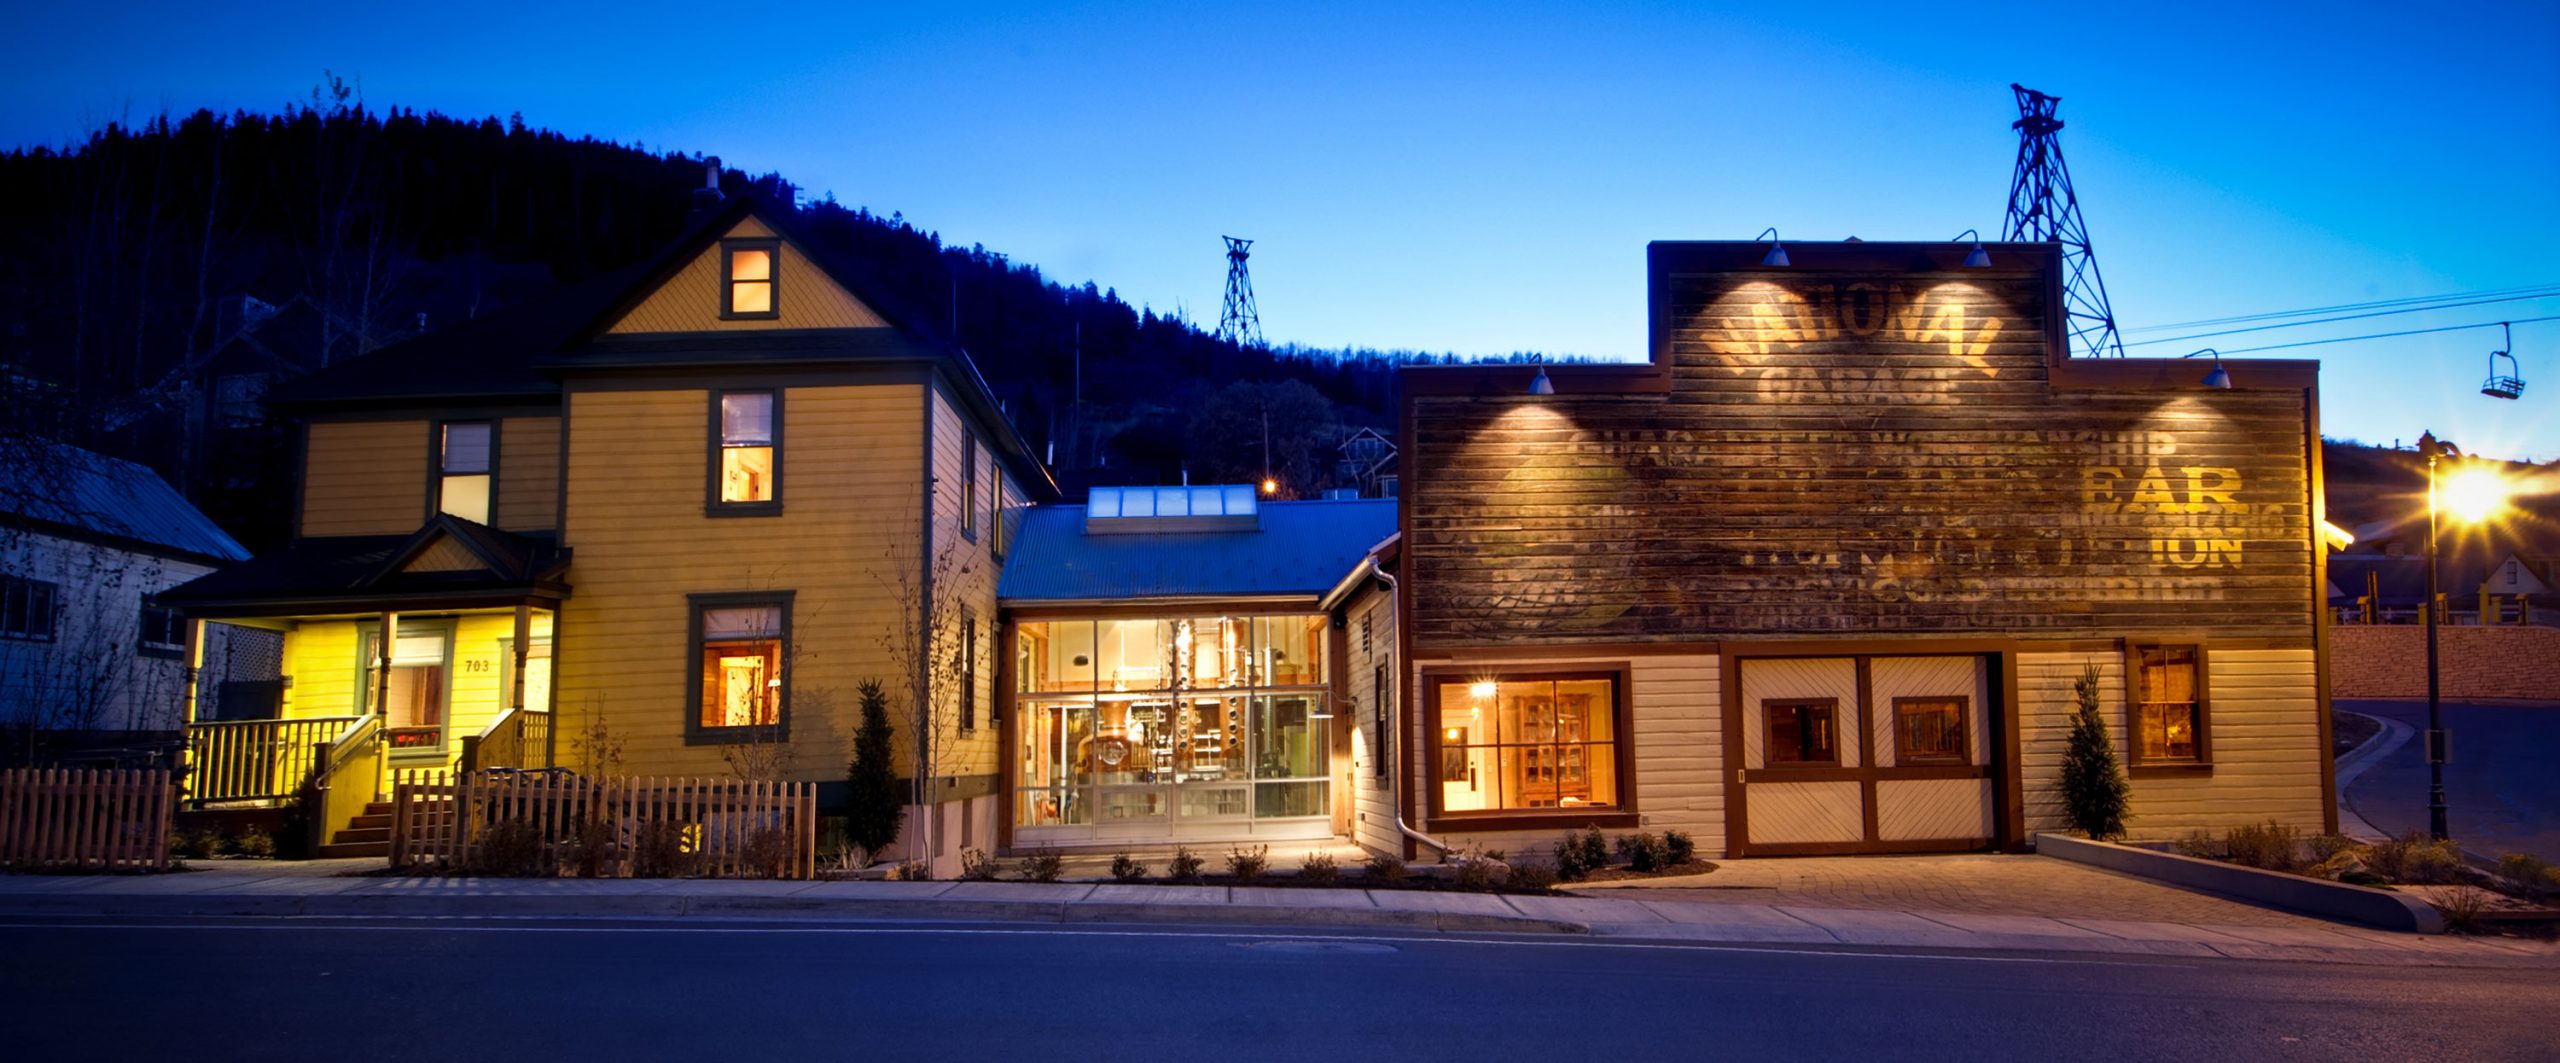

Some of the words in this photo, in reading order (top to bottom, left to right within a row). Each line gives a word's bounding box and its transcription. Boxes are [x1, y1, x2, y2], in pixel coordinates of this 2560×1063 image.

[1700, 281, 2004, 378] NATIONAL
[1755, 366, 1962, 405] GARAGE
[465, 660, 489, 672] 703
